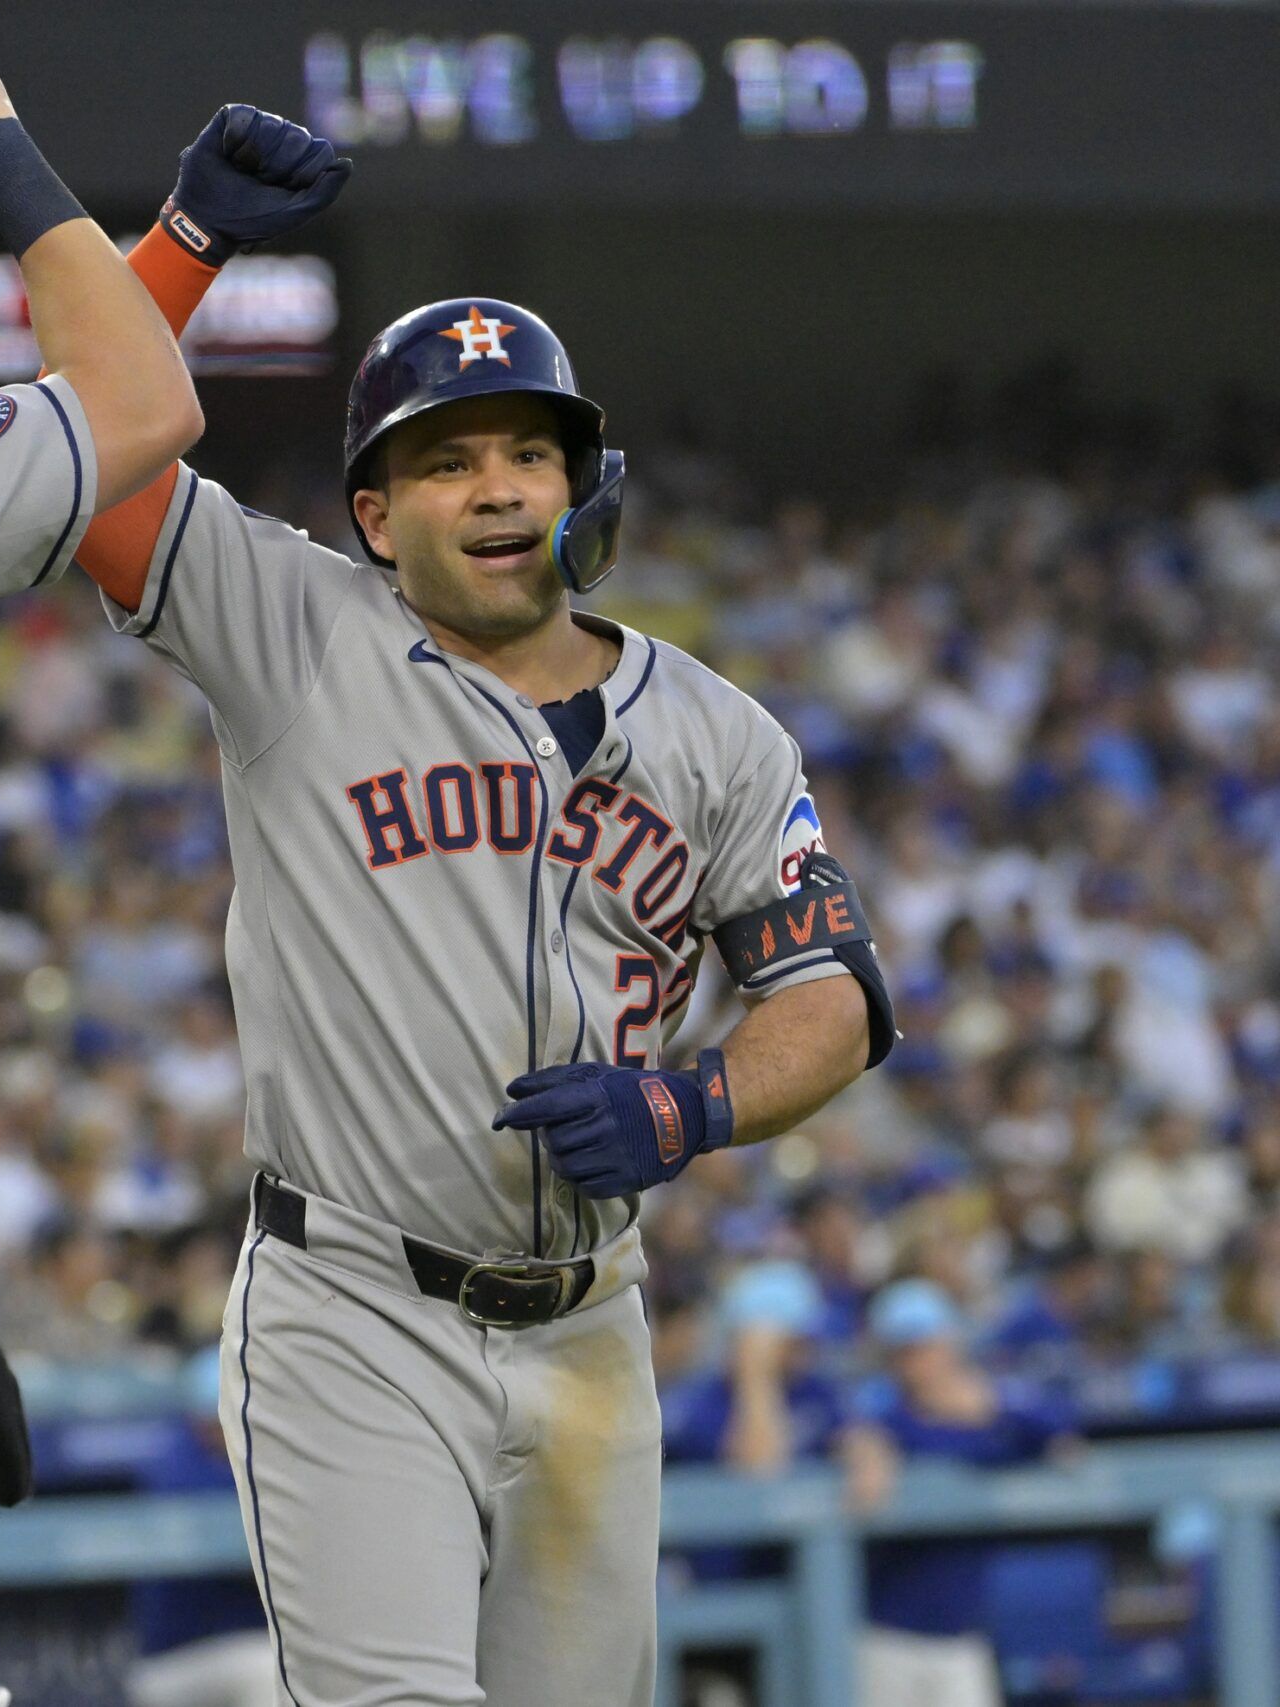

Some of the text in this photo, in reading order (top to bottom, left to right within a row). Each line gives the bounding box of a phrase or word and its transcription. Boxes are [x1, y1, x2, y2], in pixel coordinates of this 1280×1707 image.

[305, 34, 983, 144] LIVE UP TO IT
[453, 318, 509, 362] H
